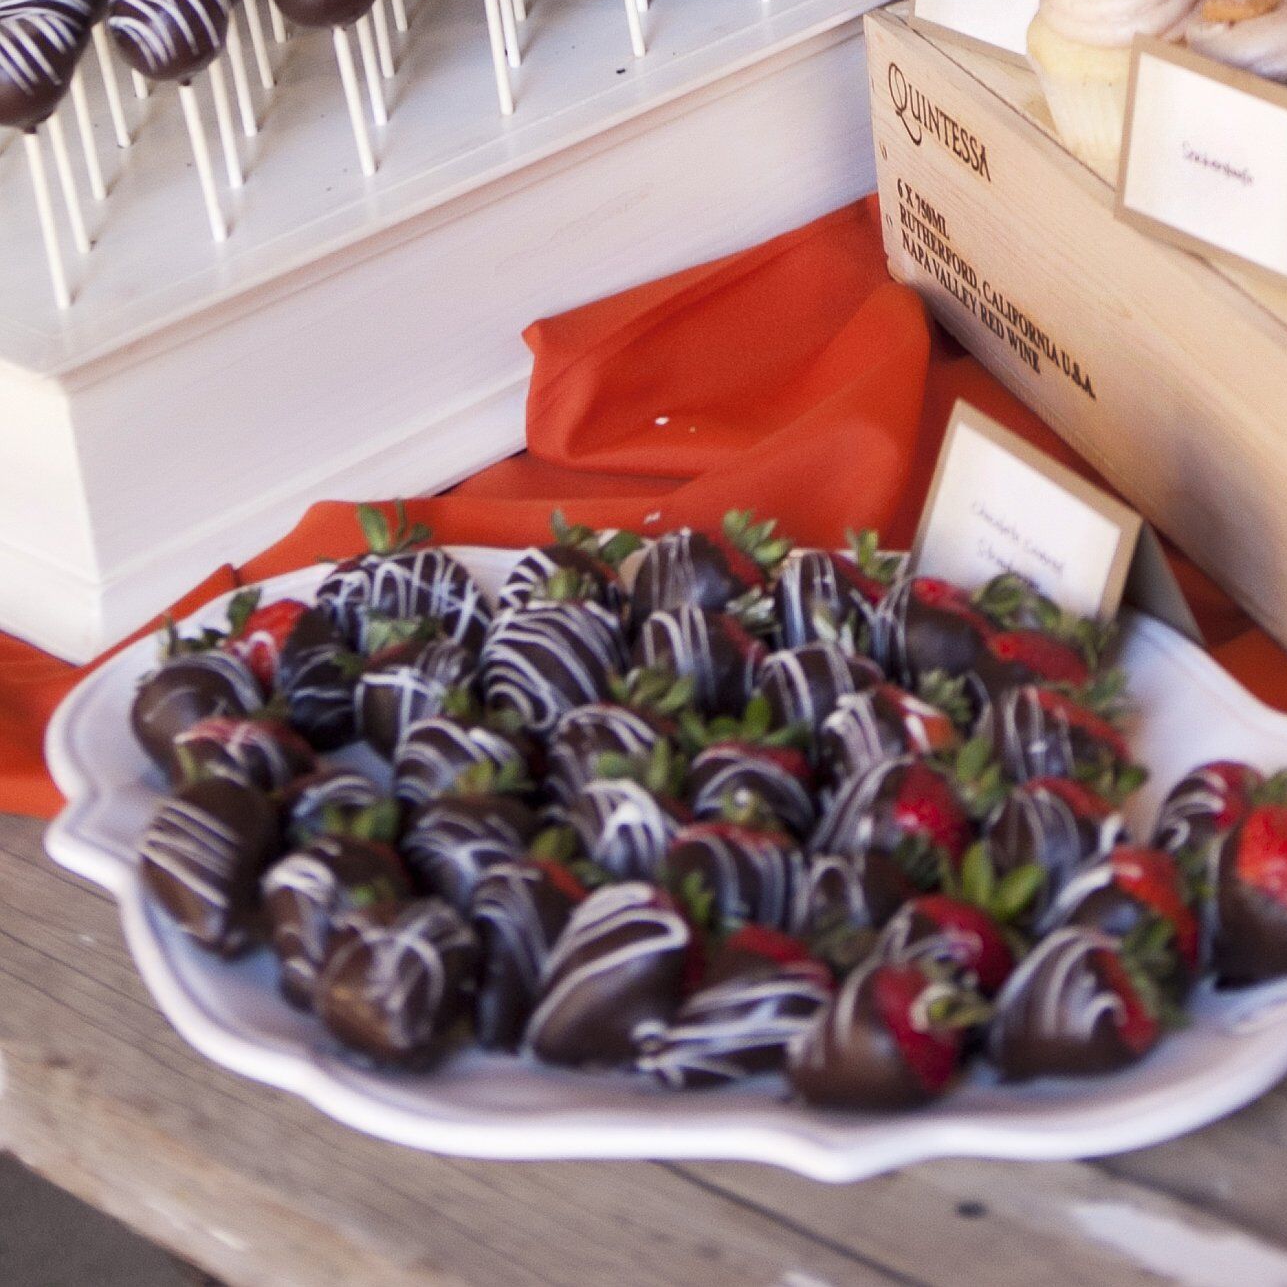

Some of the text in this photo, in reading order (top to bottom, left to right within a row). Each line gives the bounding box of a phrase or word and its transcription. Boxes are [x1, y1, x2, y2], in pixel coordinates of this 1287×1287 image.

[888, 62, 991, 182] QUINTESSA
[897, 178, 903, 199] 6
[914, 194, 950, 241] 750ML
[900, 203, 981, 295] RUTHERFORD,
[983, 280, 1060, 369] CALIFORNIA
[902, 228, 1041, 375] NAPA VALLEY RED WINE
